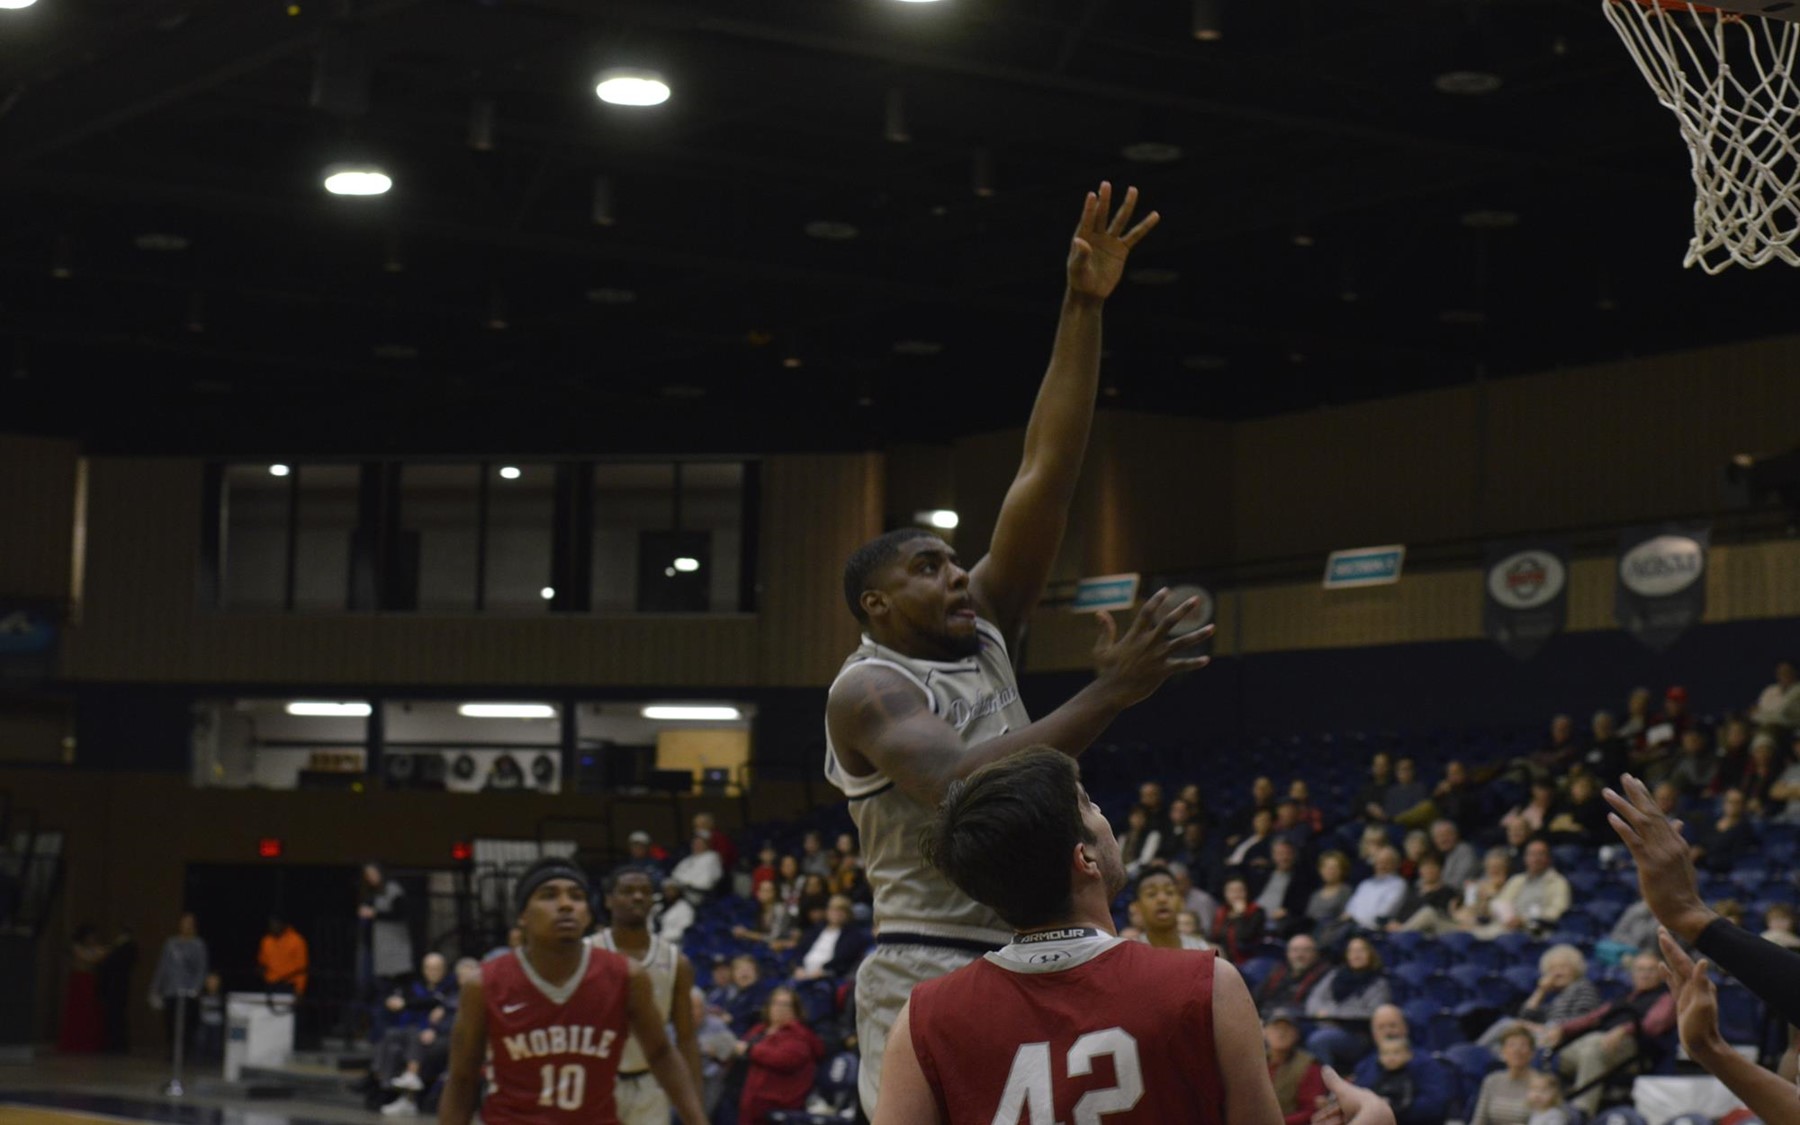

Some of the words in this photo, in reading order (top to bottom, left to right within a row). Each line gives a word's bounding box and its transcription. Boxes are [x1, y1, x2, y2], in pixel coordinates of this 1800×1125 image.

[1021, 928, 1085, 943] ARMOUR
[503, 1024, 617, 1061] MOBILE
[538, 1063, 586, 1111] 10
[991, 1026, 1146, 1125] 42
